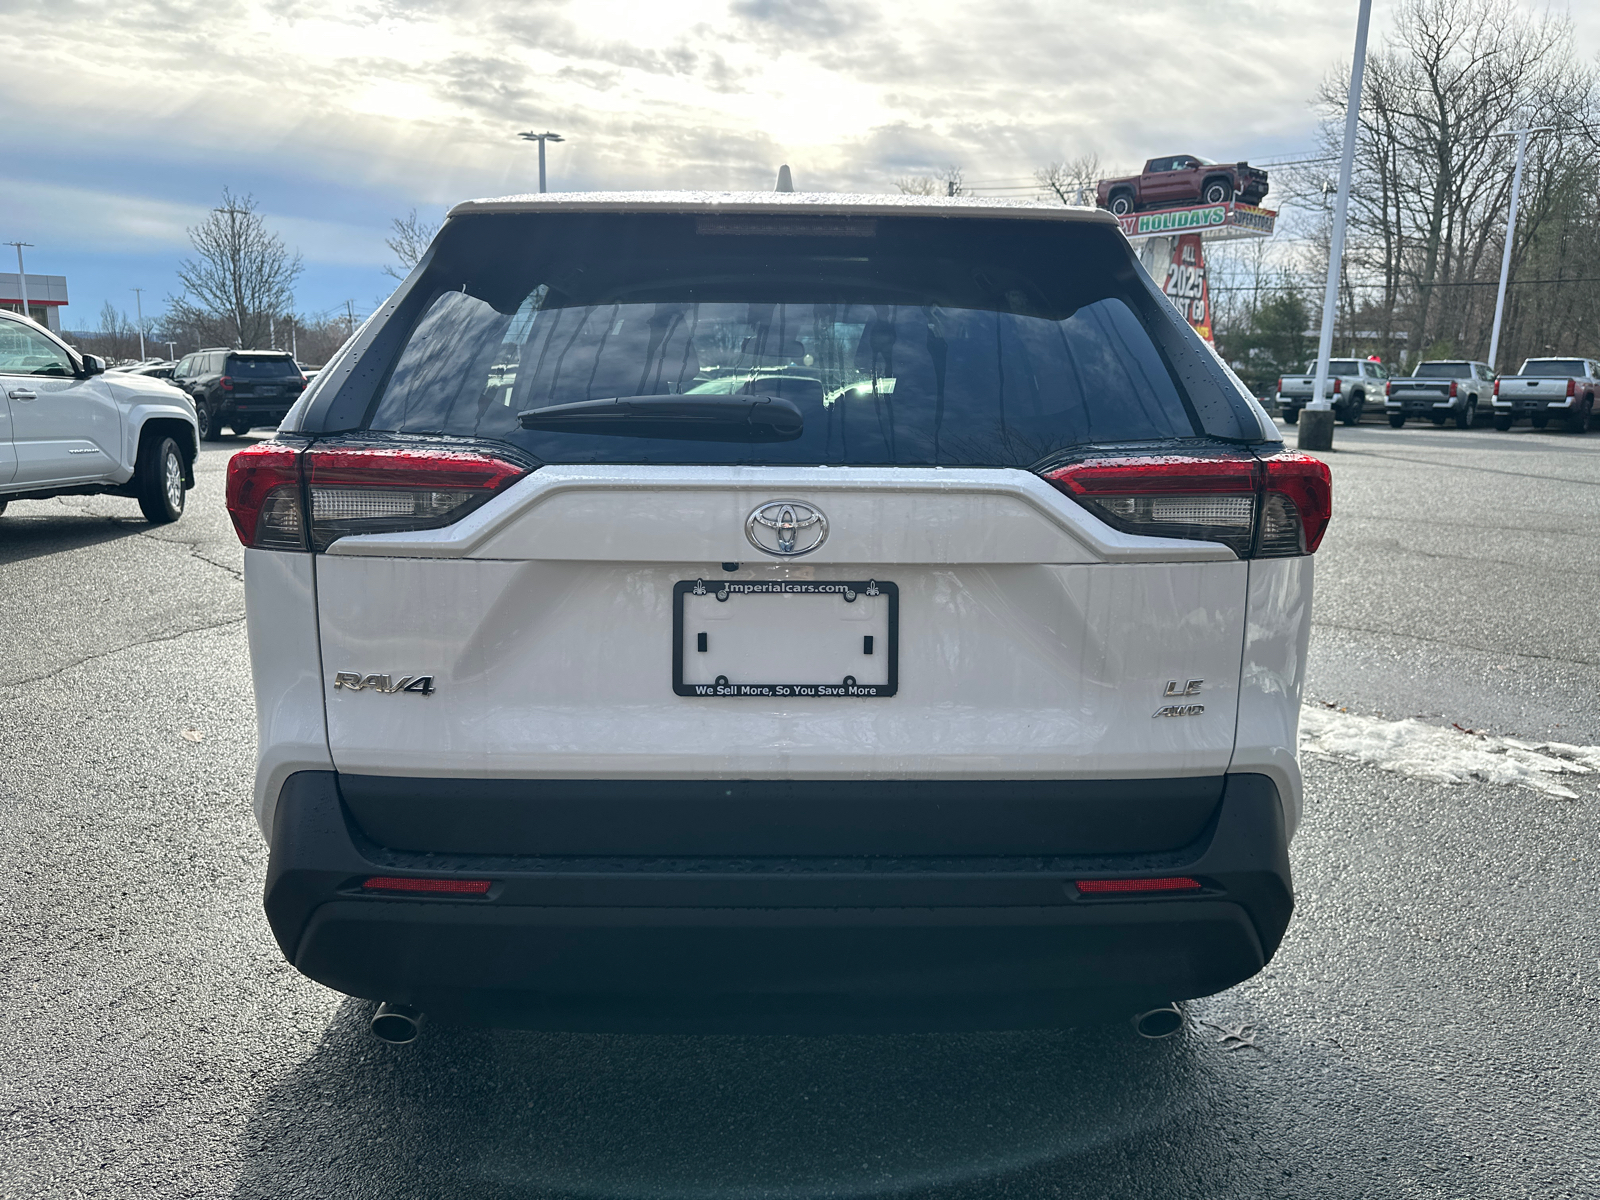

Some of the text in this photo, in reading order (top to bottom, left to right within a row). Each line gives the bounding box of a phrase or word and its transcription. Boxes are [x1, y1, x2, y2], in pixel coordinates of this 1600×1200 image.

[1138, 206, 1226, 233] HOLIDAYS
[1233, 209, 1274, 232] SUPERSTORE
[1182, 245, 1196, 262] ALL
[1166, 263, 1204, 298] 2025
[1169, 296, 1205, 321] ST GO
[723, 582, 849, 594] Imperialcars.com
[334, 671, 436, 696] RAV4
[696, 685, 876, 697] We Sell More, So You Save More
[1163, 678, 1204, 697] LE
[1152, 703, 1204, 718] AWD
